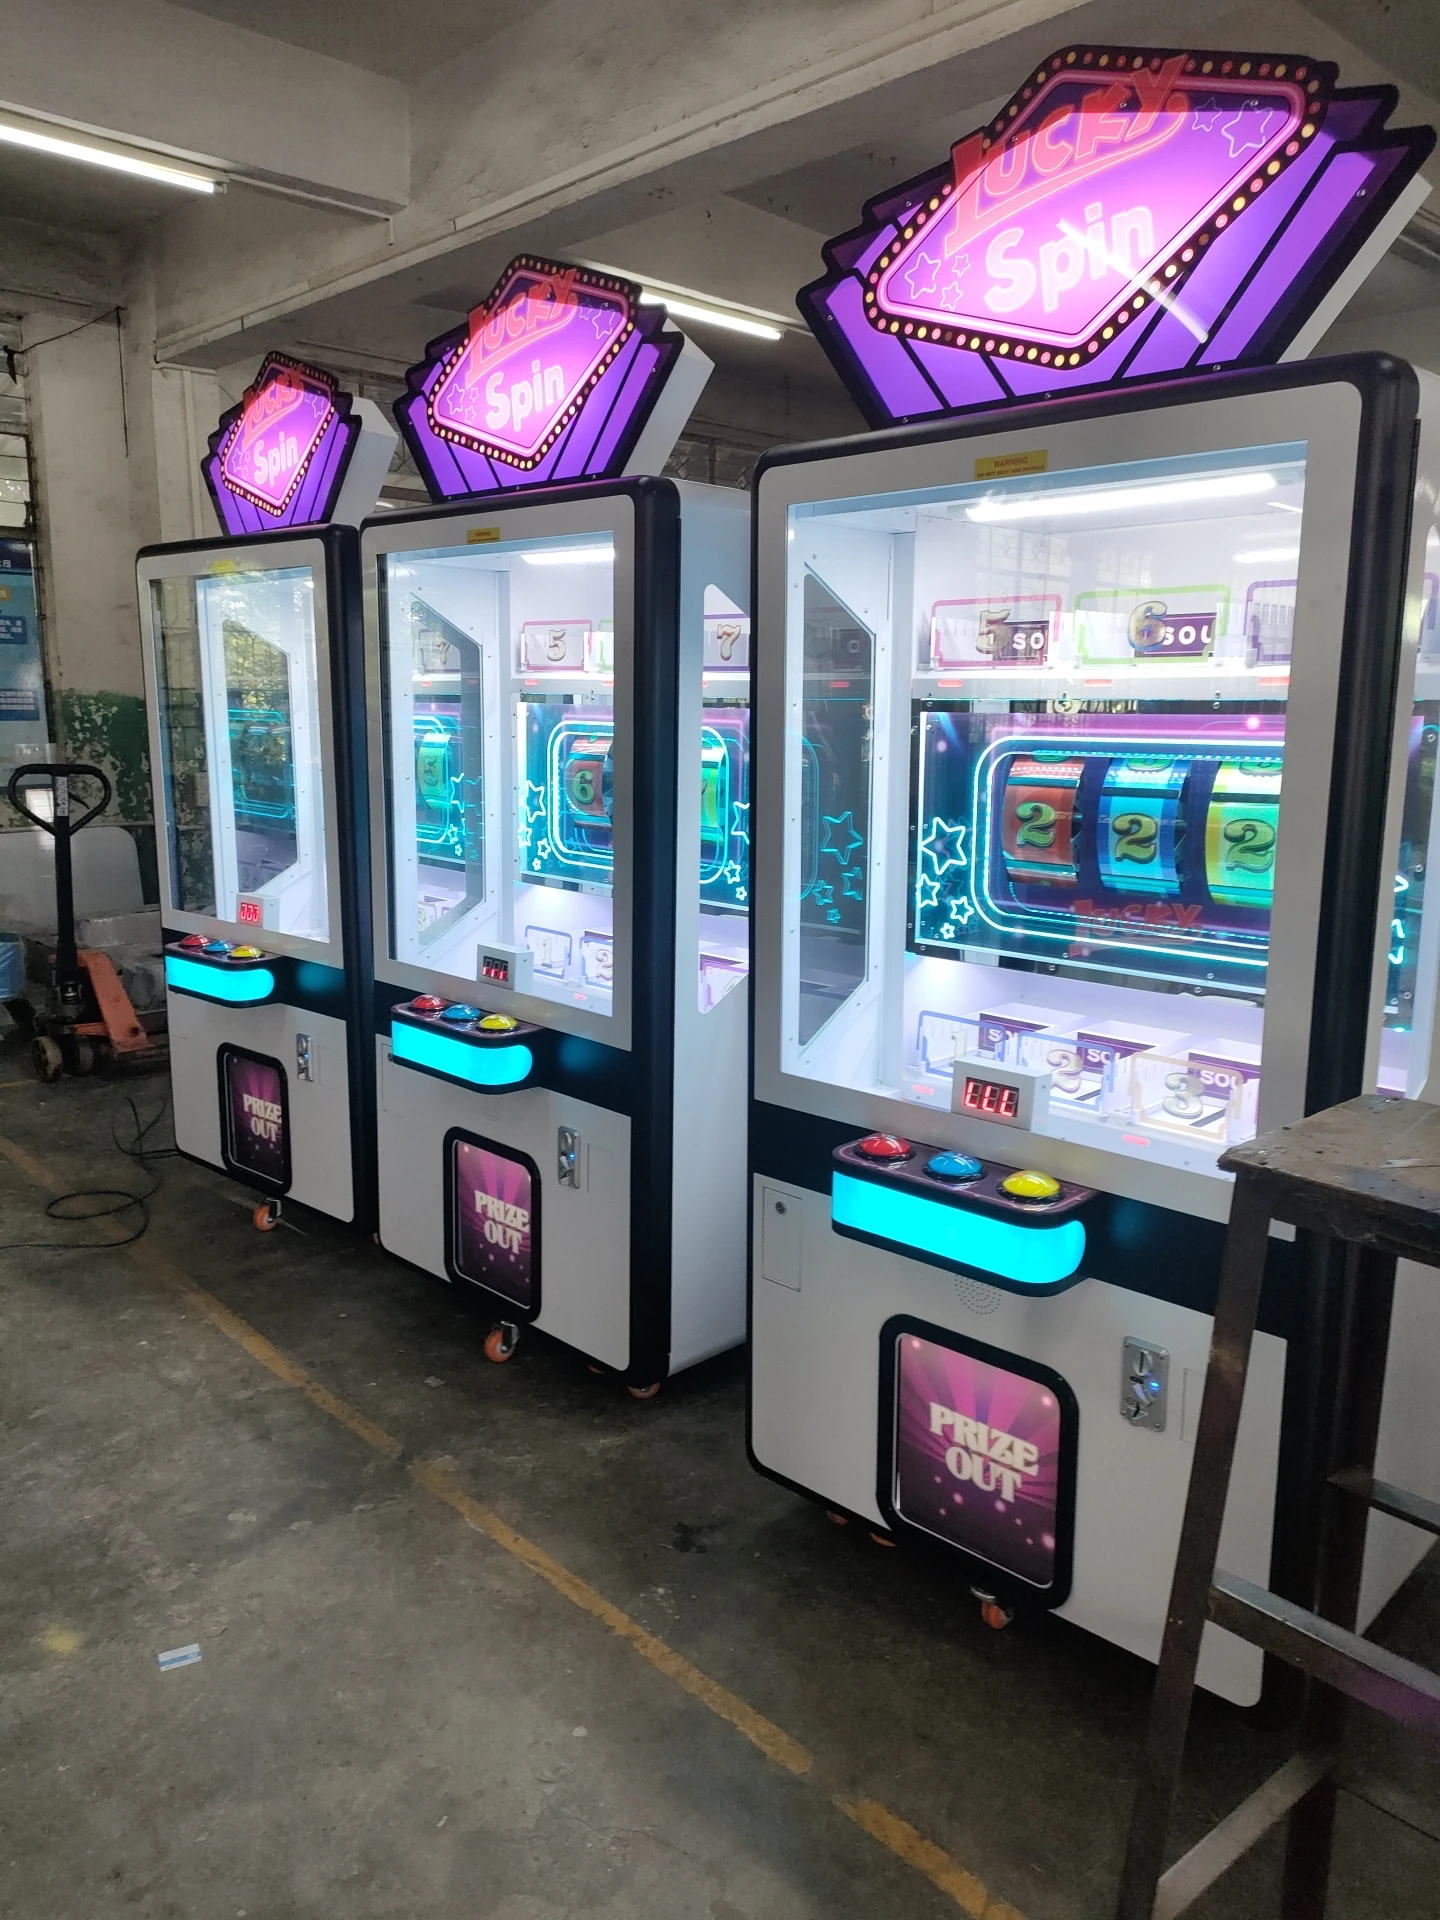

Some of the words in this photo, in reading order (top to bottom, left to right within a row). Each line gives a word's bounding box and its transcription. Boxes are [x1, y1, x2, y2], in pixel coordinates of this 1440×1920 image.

[983, 201, 1155, 316] Spin
[485, 359, 565, 432] Spin
[253, 431, 299, 487] Spin
[547, 628, 567, 662] 5
[717, 624, 742, 662] 7
[975, 608, 1012, 655] 5
[1127, 600, 1168, 653] 6
[572, 769, 595, 805] 6
[1016, 801, 1056, 850] 2
[1112, 812, 1158, 865] 2
[1224, 818, 1275, 874] 2
[1046, 1048, 1084, 1094] 2
[242, 1093, 283, 1124] PRIZE
[1162, 1072, 1205, 1120] 3
[250, 1116, 278, 1143] OUT
[474, 1189, 531, 1234] PRIZE
[483, 1219, 523, 1255] OUT
[929, 1401, 1040, 1478] PRIZE
[945, 1445, 1023, 1503] OUT
